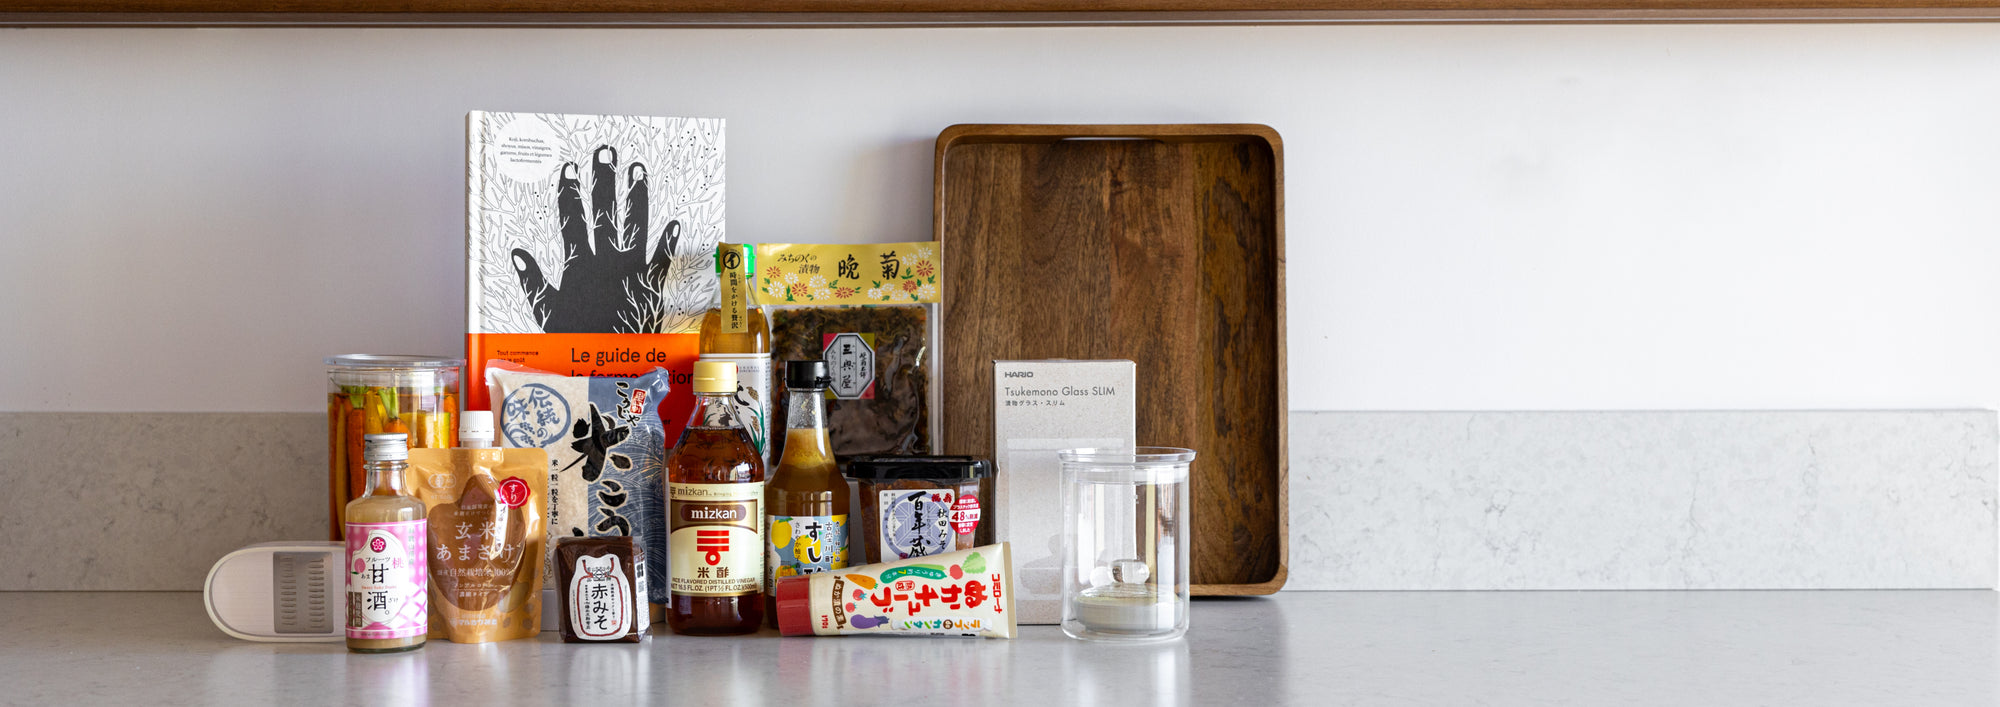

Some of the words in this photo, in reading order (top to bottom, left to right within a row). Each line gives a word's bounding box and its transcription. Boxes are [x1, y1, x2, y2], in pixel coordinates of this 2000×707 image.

[777, 253, 817, 264] みちのくの
[798, 264, 820, 274] 漬物
[571, 347, 590, 362] Le
[596, 347, 641, 366] guide
[645, 347, 667, 362] de
[1005, 386, 1058, 397] Tsukemono
[1061, 386, 1089, 396] Glass
[1092, 386, 1115, 396] SLIM
[507, 398, 530, 421] 味
[677, 486, 708, 496] mizkan
[691, 507, 737, 519] mizkan
[455, 521, 496, 539] 玄米
[937, 508, 953, 550] 秋田みそ
[392, 557, 405, 569] 桃
[697, 567, 729, 578] 米酢
[870, 580, 989, 617] ぬかチューブ
[591, 583, 609, 630] 赤みそ
